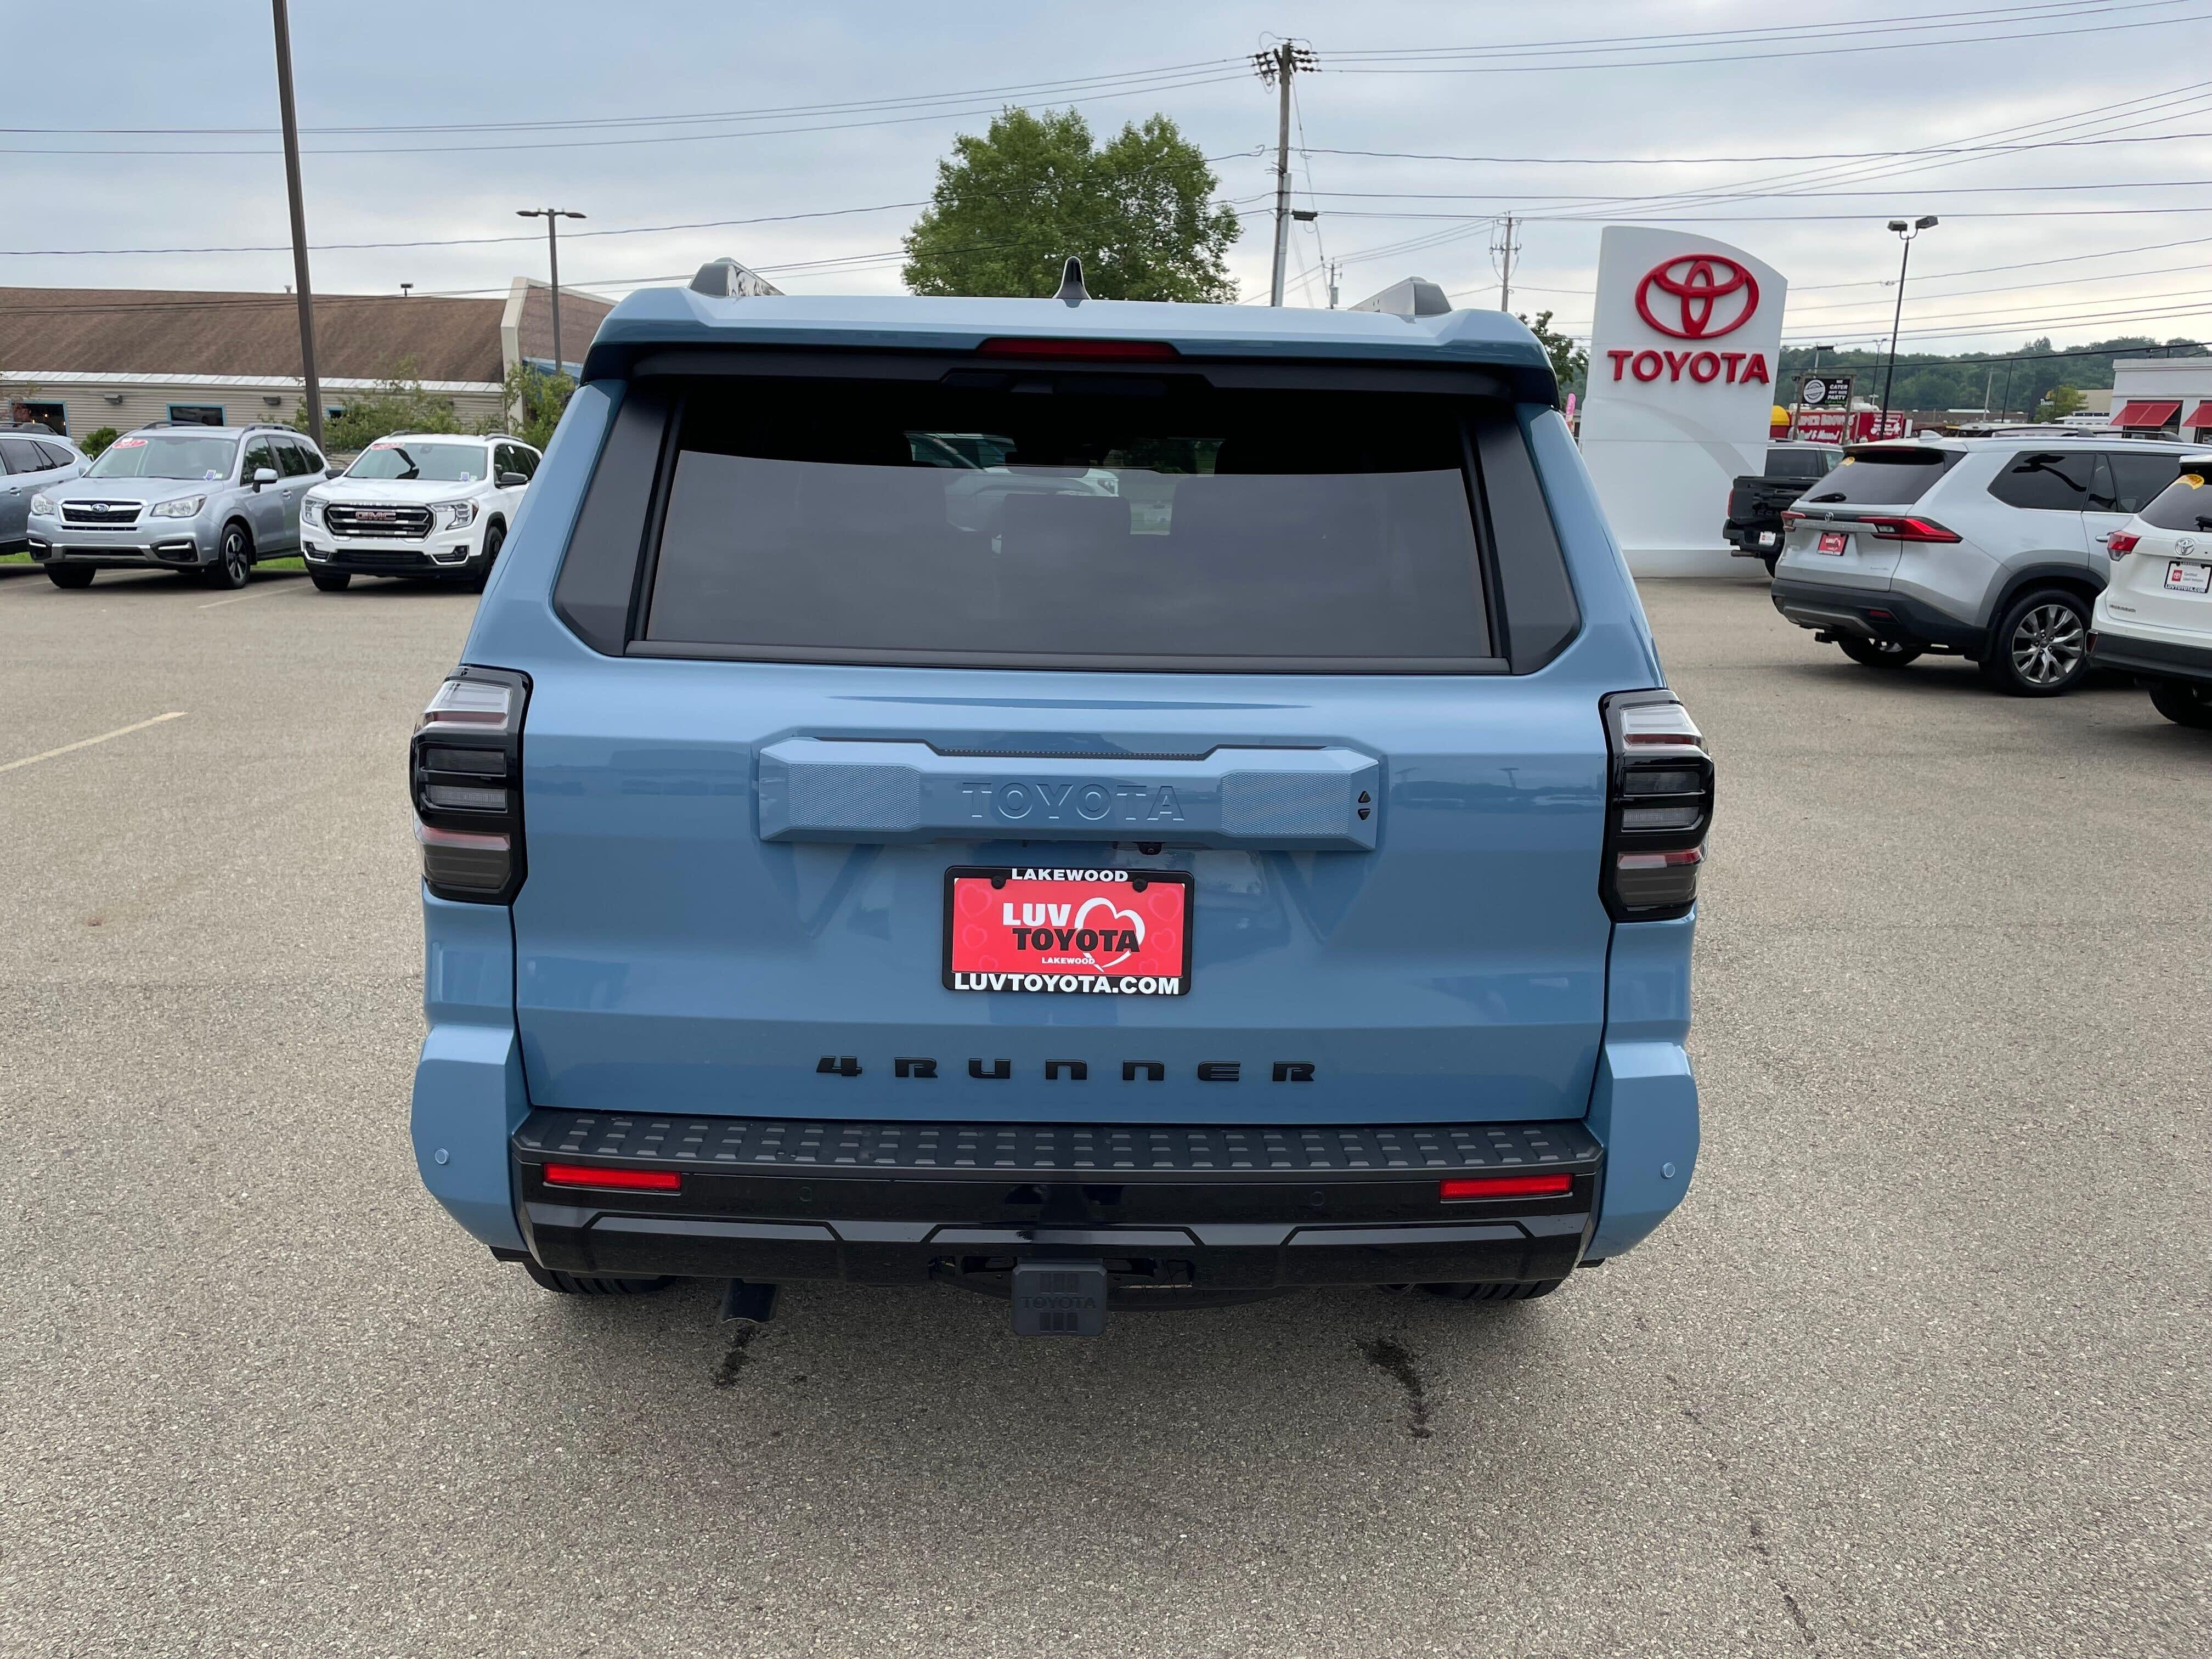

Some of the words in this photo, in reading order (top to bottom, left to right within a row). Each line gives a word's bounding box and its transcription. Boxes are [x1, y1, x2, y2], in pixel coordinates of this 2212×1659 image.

[1607, 350, 1770, 383] TOYOTA
[355, 511, 396, 521] GMC
[2165, 584, 2205, 592] LUVTOYOTA.COM
[962, 782, 1185, 821] TOYOTA
[1012, 868, 1128, 882] LAKEWOOD
[1003, 902, 1072, 926] LUV
[1012, 928, 1140, 952] TOYOTA
[1042, 957, 1096, 965] LAKEWOOD
[955, 972, 1179, 995] LUVTOYOTA.COM
[1019, 1296, 1097, 1310] TOYOTA
